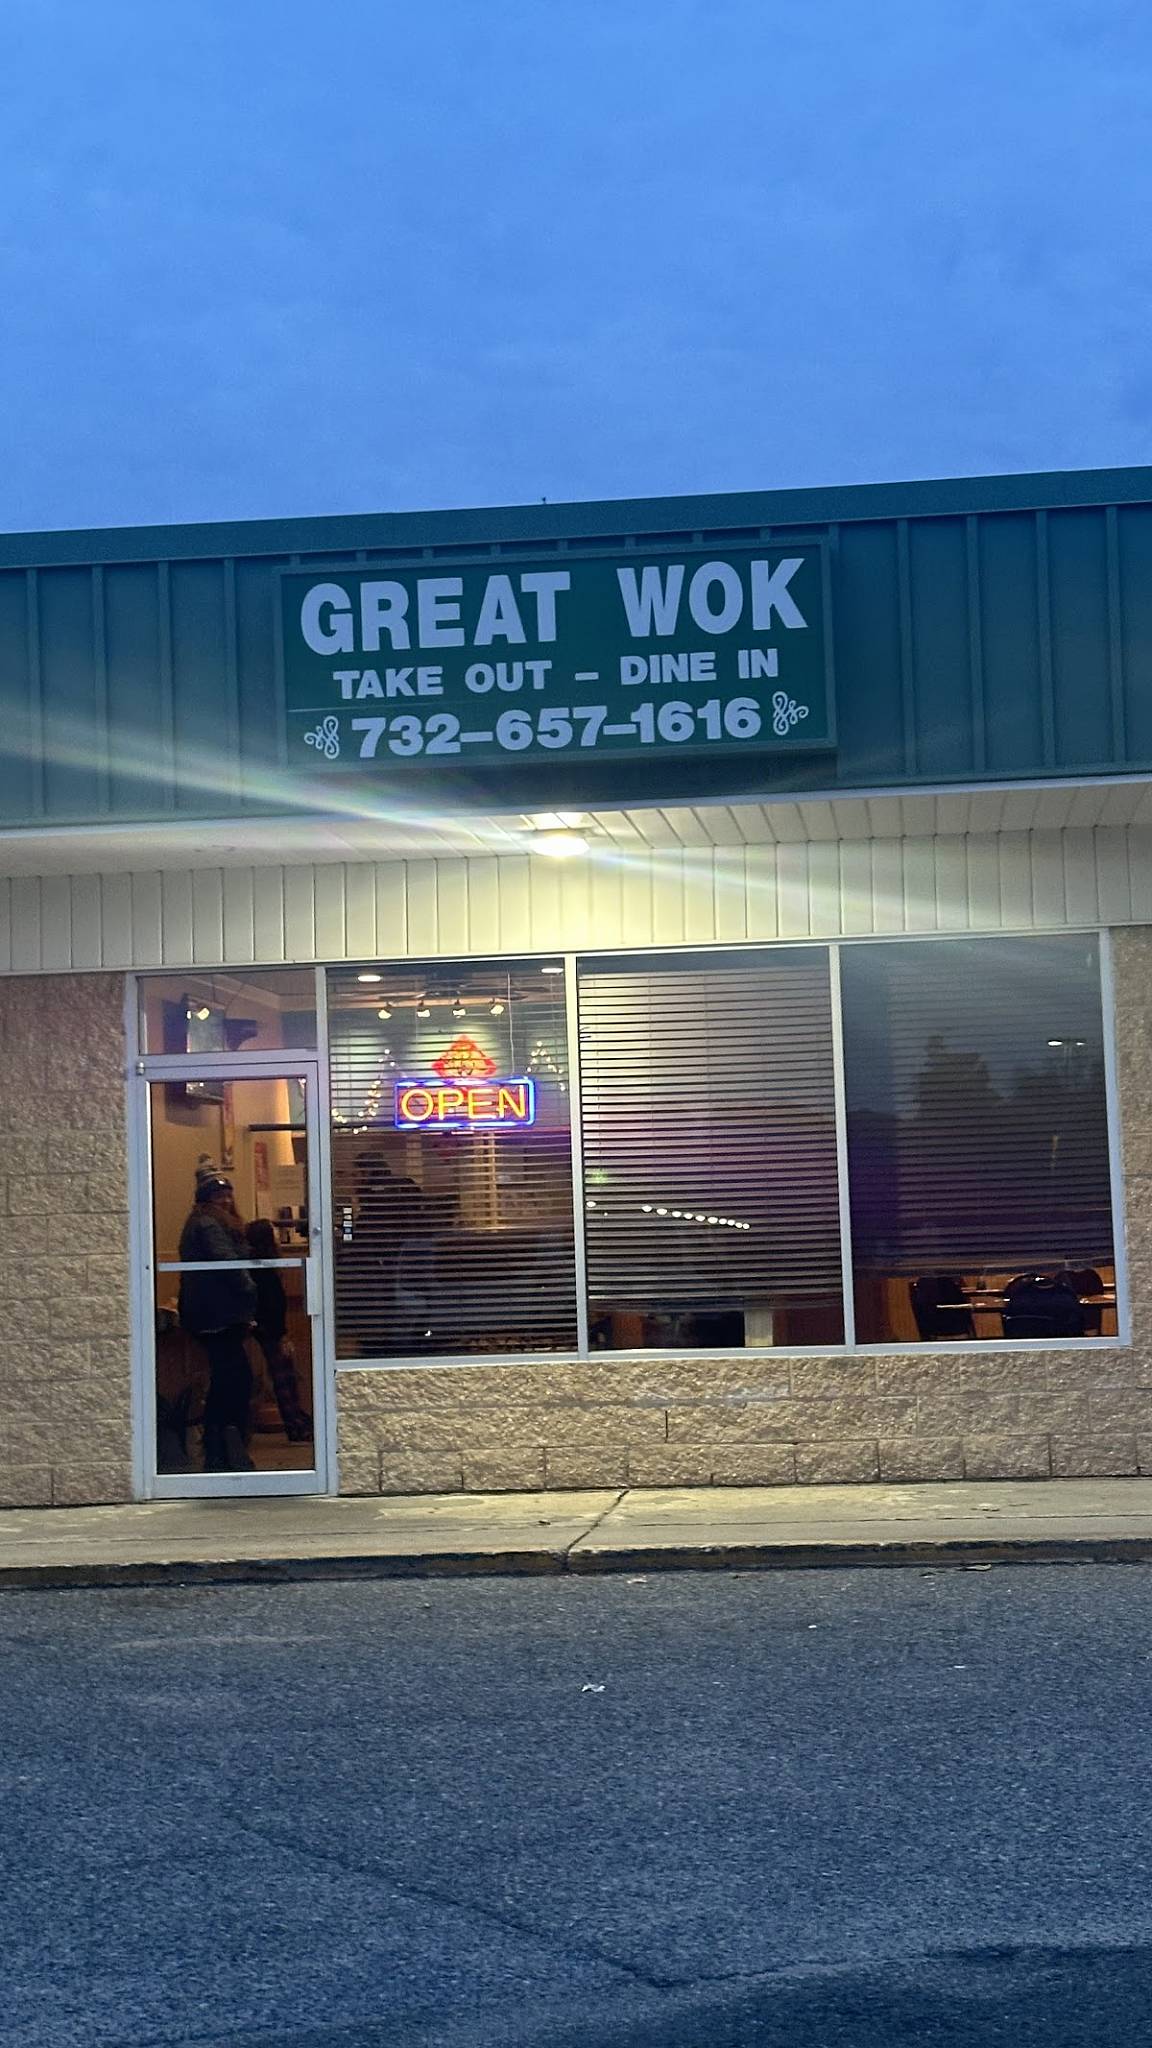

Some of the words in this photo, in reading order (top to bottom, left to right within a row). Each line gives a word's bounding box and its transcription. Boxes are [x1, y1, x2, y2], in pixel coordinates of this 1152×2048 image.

[301, 571, 571, 656] GREAT
[616, 558, 809, 637] WOK
[333, 666, 443, 700] TAKE
[465, 660, 552, 693] OUT
[620, 651, 717, 686] DINE
[738, 648, 778, 679] IN
[351, 697, 761, 759] 732-657-1616
[401, 1084, 526, 1121] OPEN
